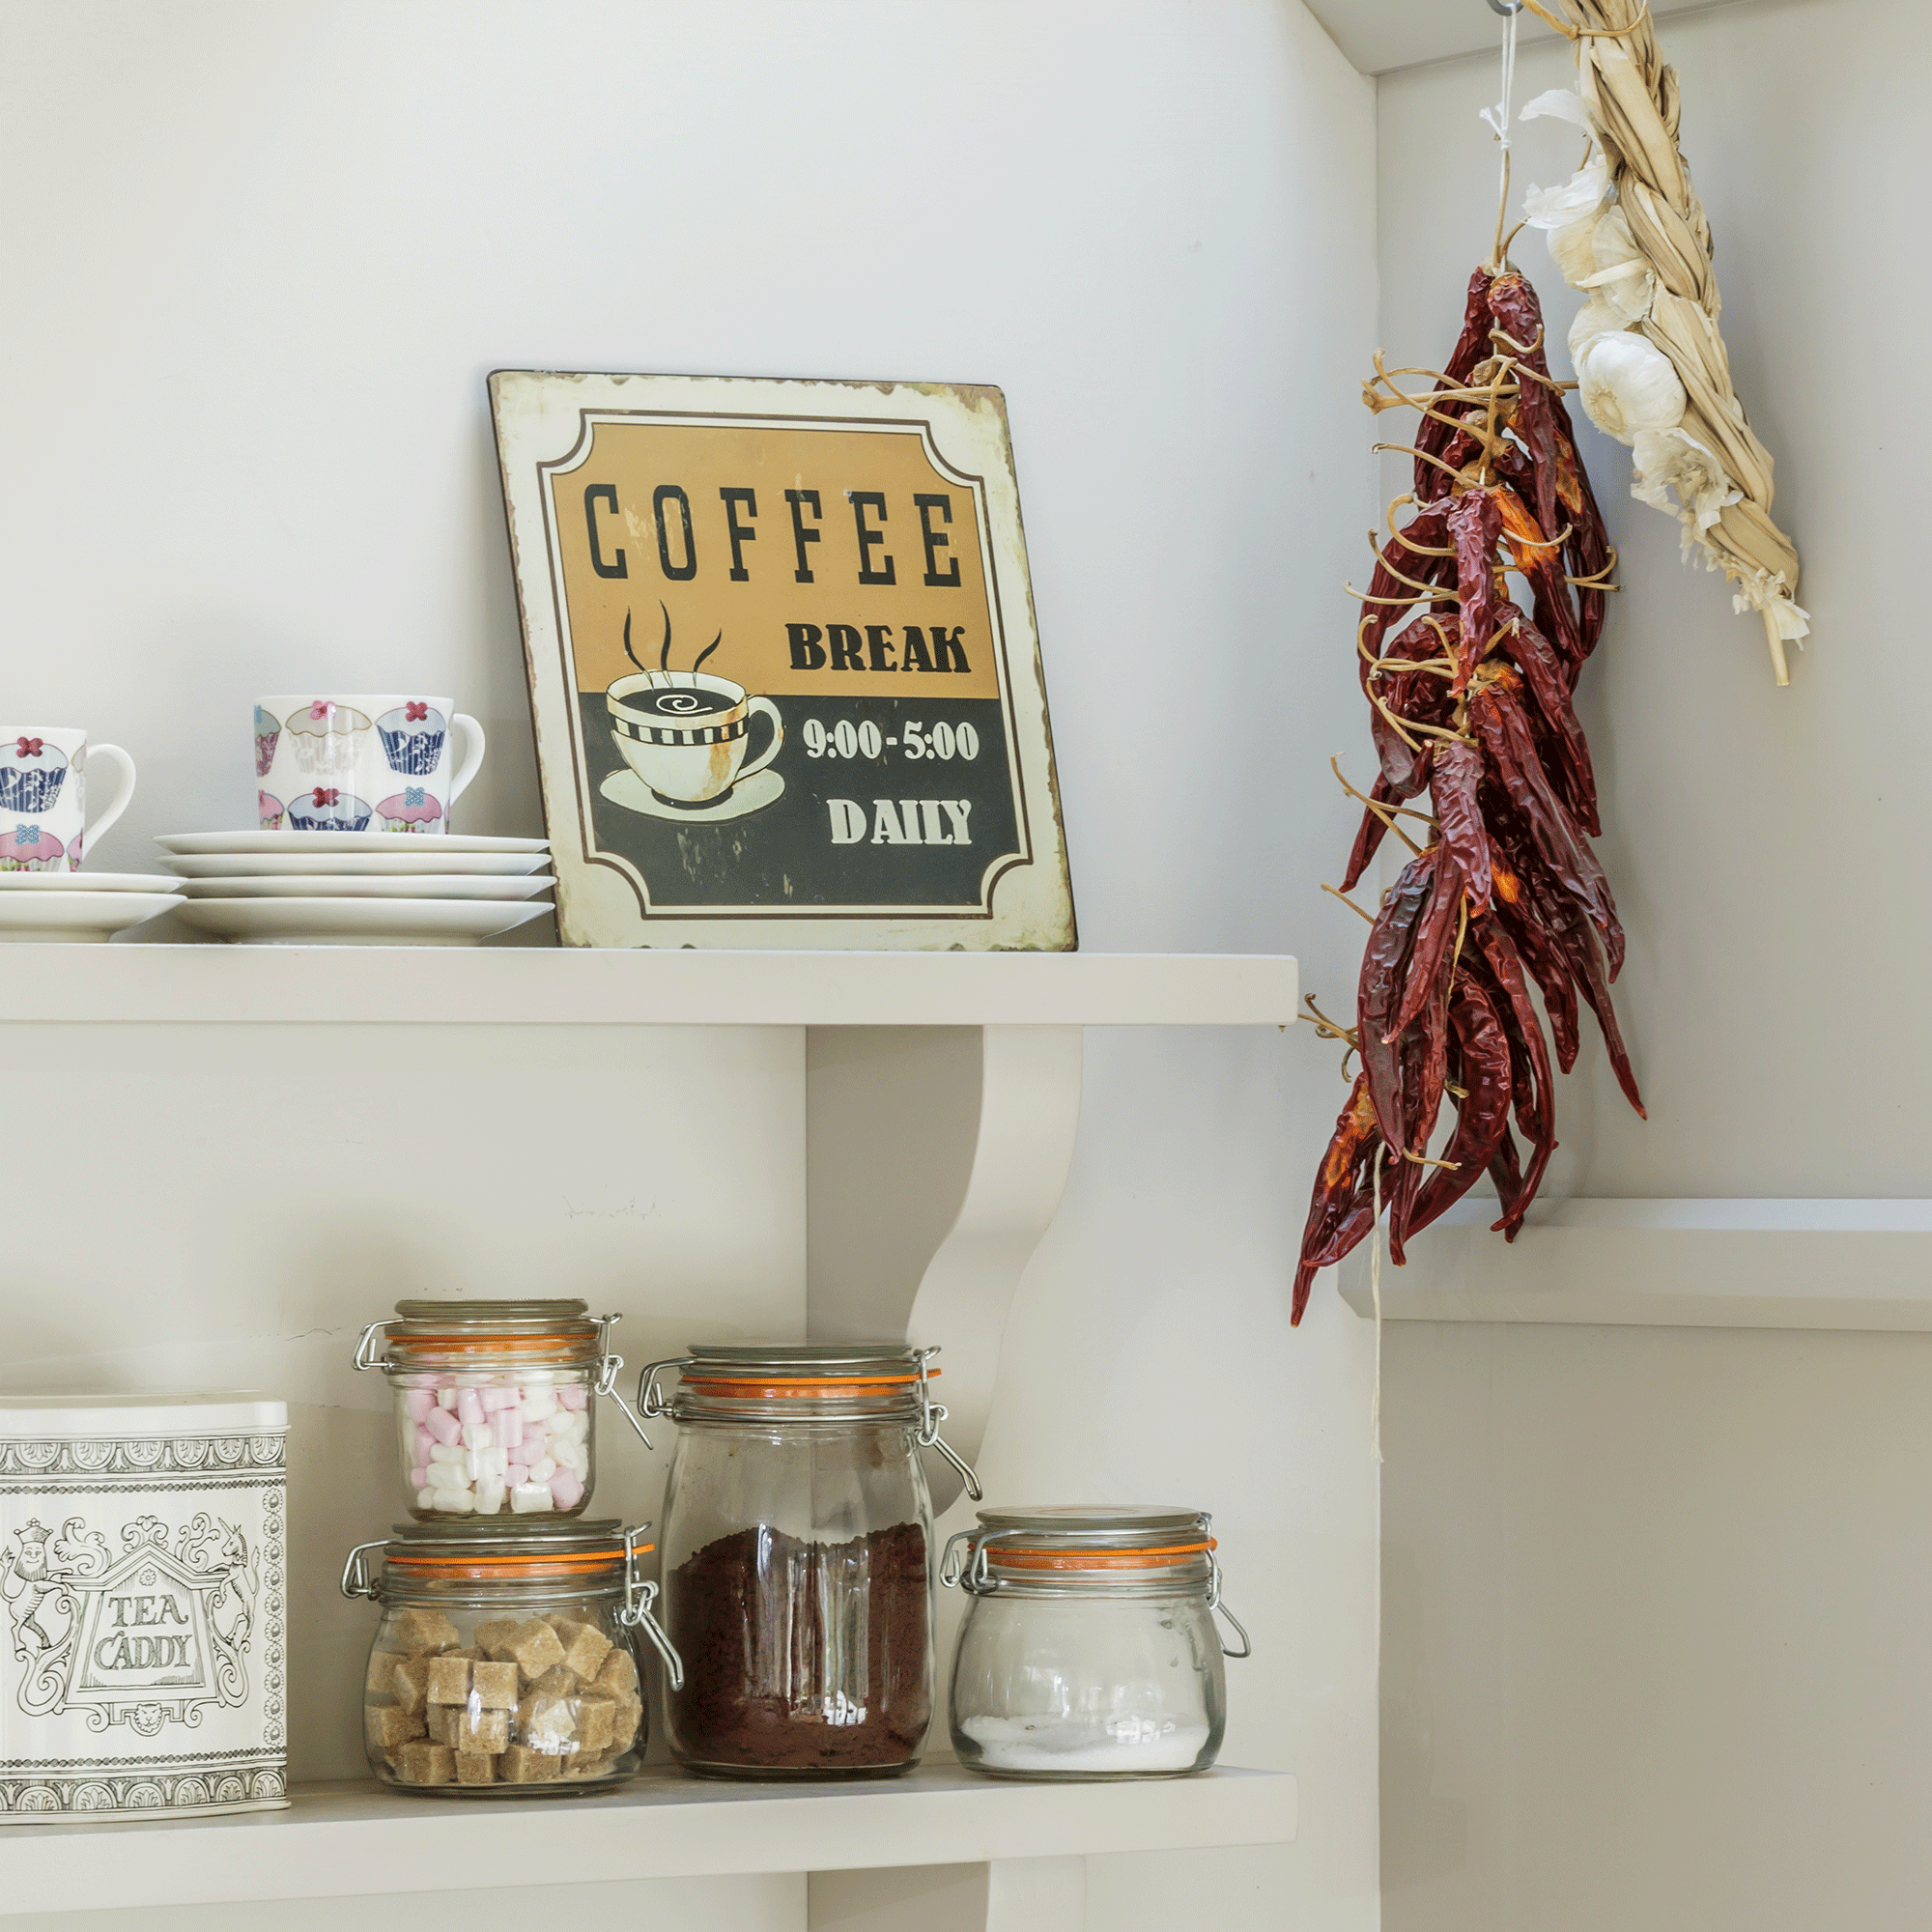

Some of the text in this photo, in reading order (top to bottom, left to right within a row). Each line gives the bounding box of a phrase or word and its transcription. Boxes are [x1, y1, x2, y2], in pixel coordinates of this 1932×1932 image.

[584, 483, 961, 586] COFFEE
[785, 624, 972, 672] BREAK
[826, 799, 973, 844] DAILY
[108, 1594, 189, 1628] TEA
[95, 1631, 192, 1670] CADDY
